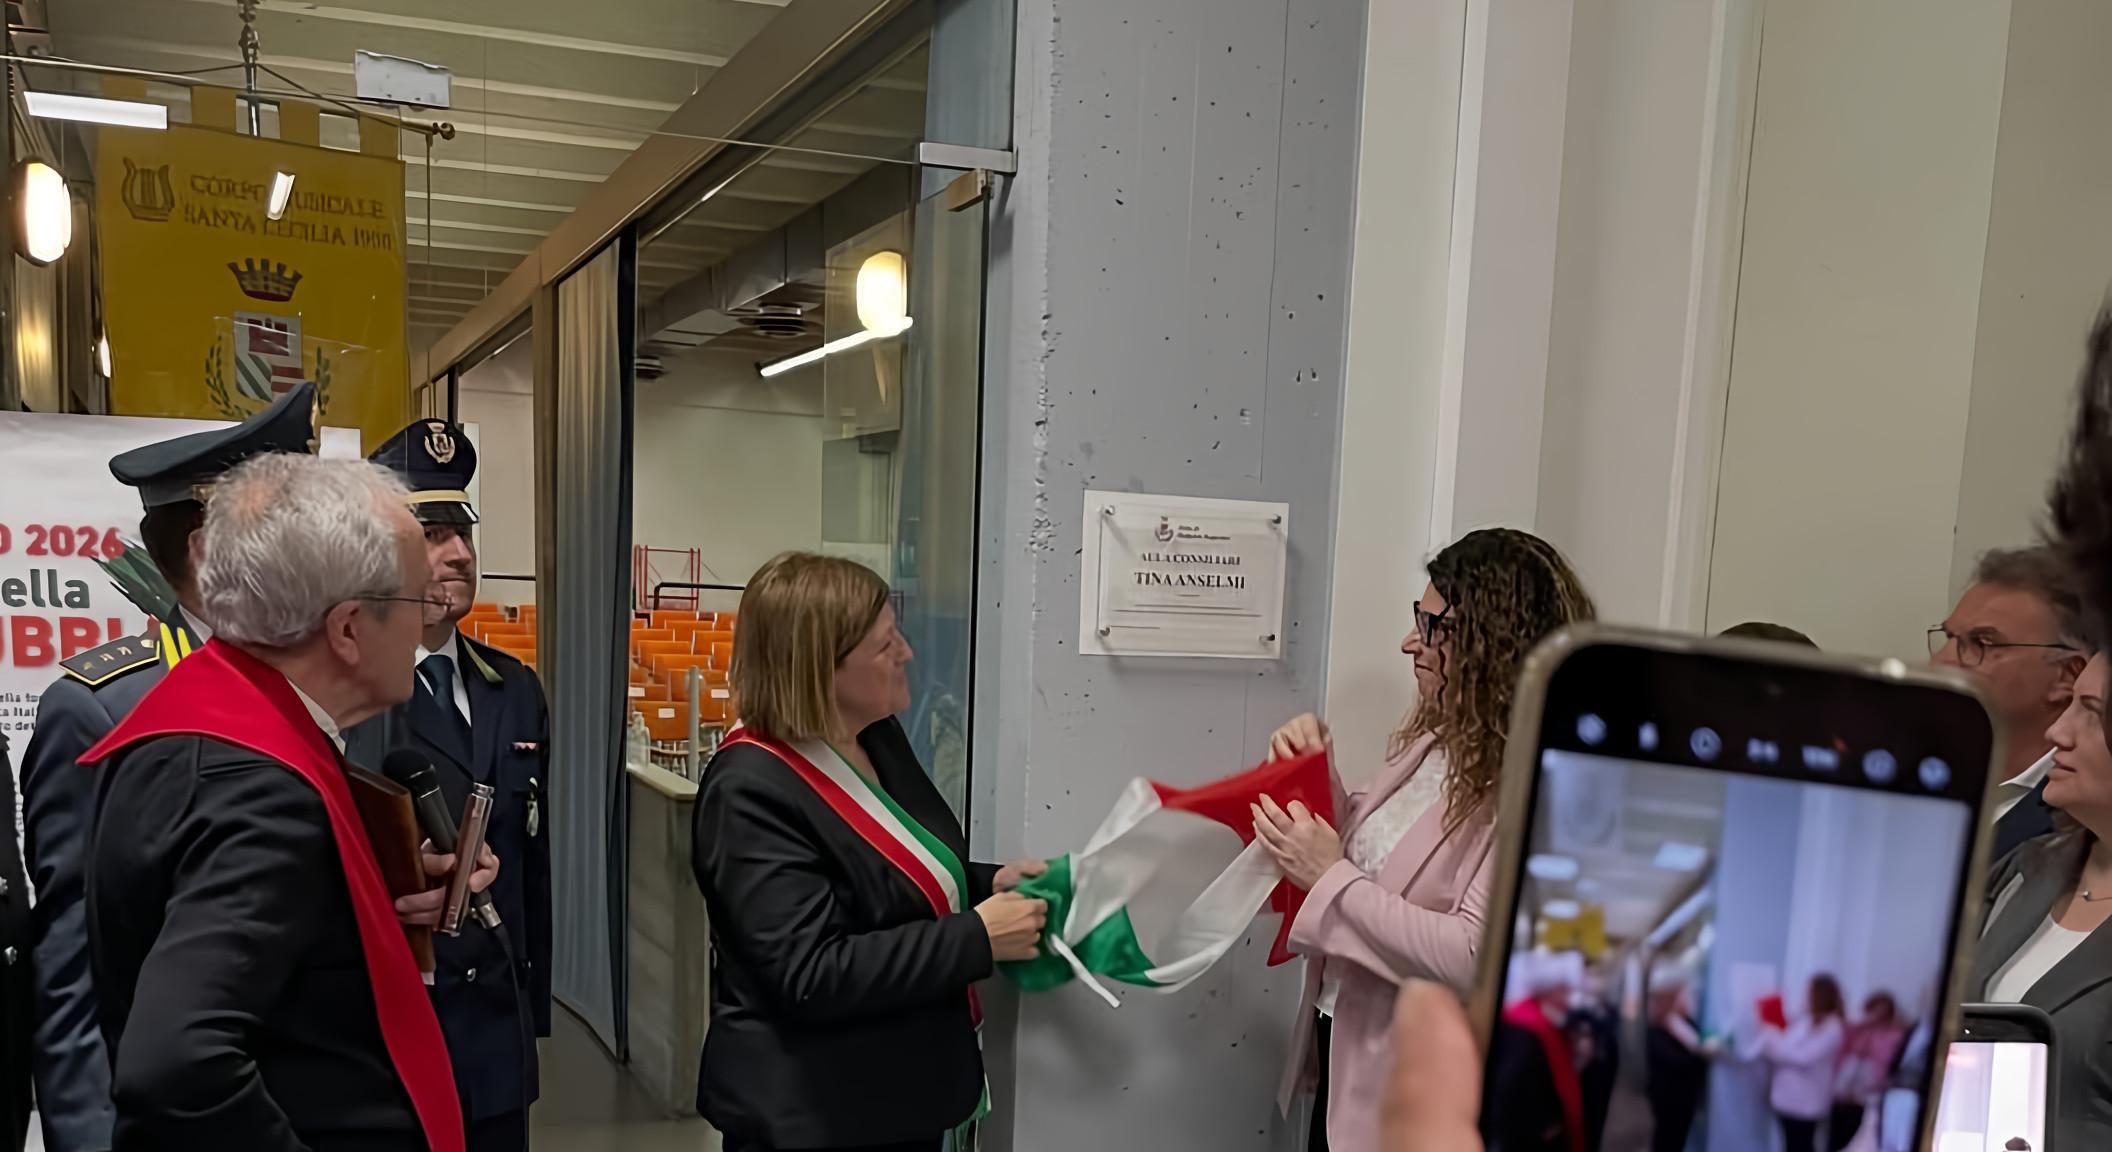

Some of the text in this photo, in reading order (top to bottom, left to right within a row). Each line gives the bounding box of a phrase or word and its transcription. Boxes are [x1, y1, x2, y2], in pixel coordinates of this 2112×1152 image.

[25, 524, 126, 561] 2026
[0, 568, 90, 608] ella
[1134, 571, 1245, 590] TINA ANSELMI
